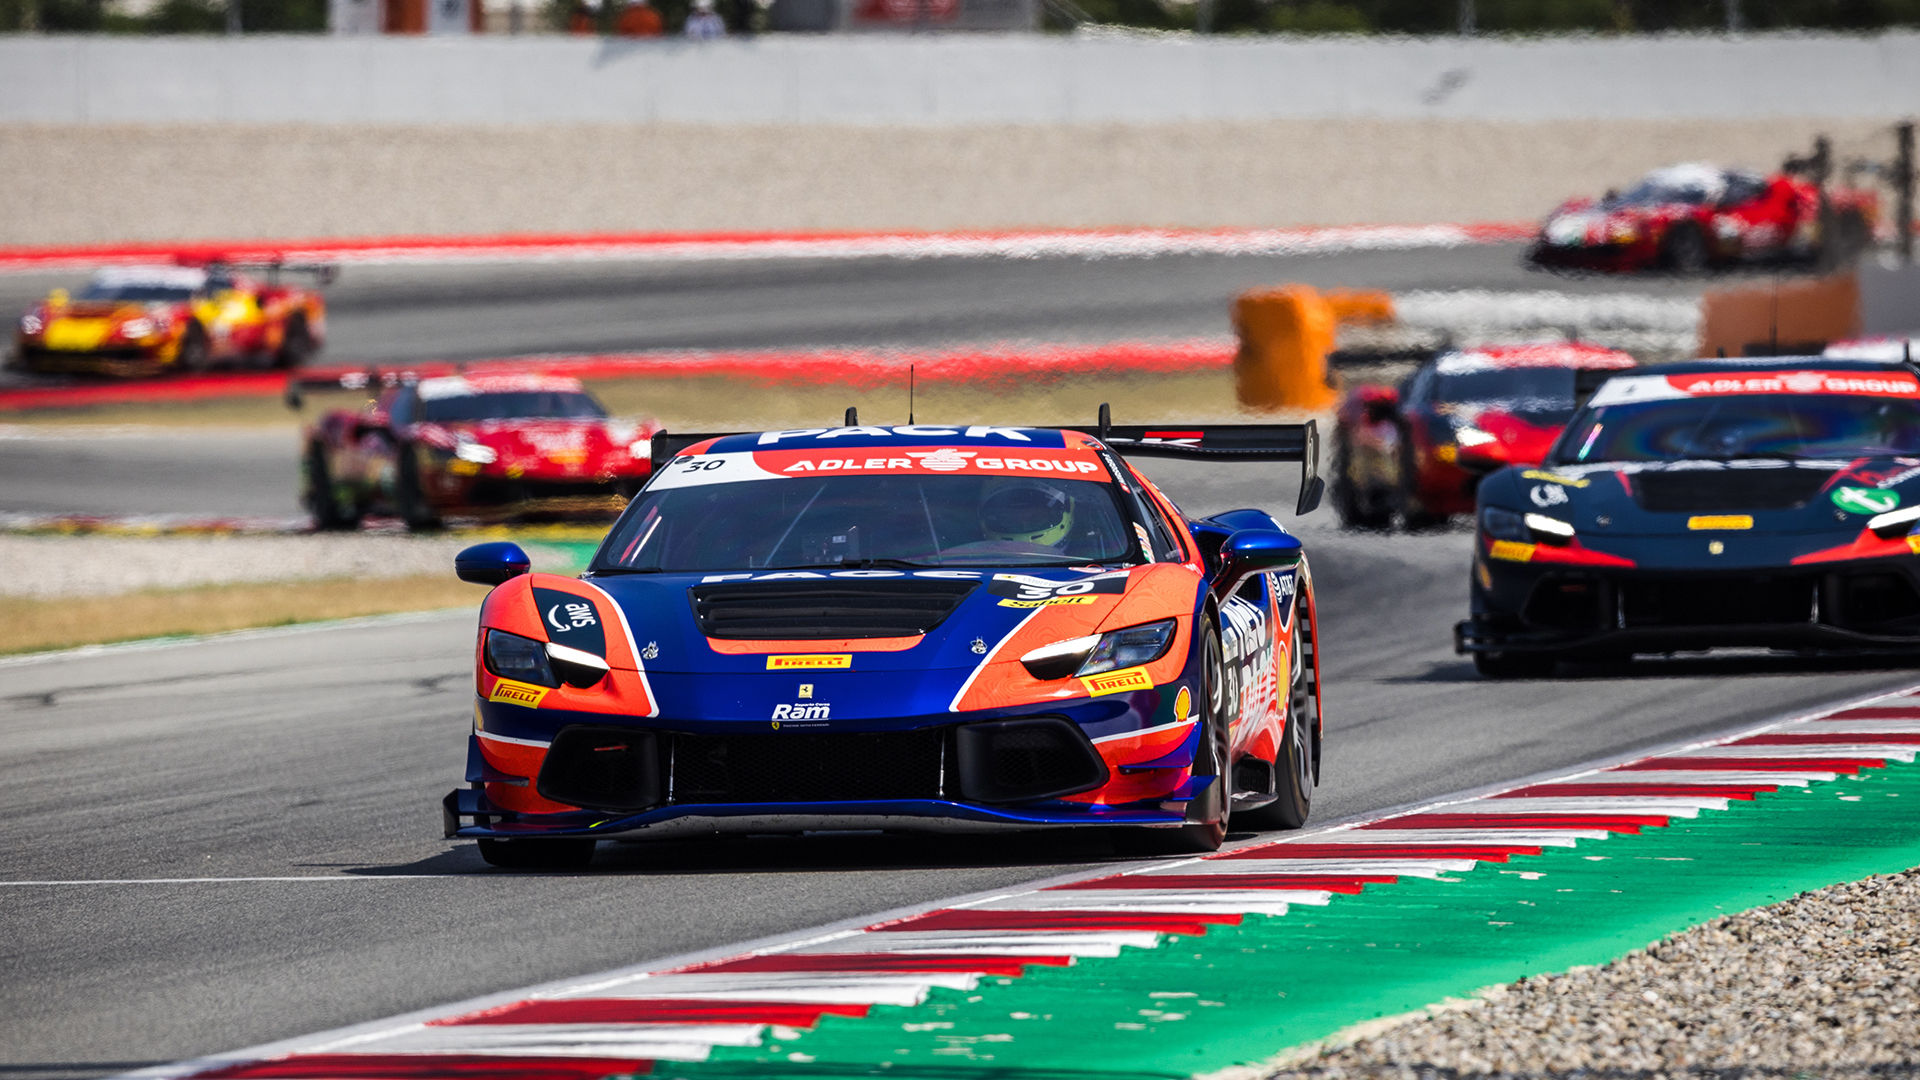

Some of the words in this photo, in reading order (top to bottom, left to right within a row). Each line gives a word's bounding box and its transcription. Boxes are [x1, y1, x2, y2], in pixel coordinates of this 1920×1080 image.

[682, 459, 725, 473] 30
[783, 458, 912, 472] ADLER
[975, 457, 1098, 473] GROUP
[1016, 582, 1095, 599] 30
[565, 603, 596, 627] aws
[1088, 671, 1147, 692] PIRELLI
[494, 683, 542, 703] PIRELLI
[771, 703, 831, 720] Ram
